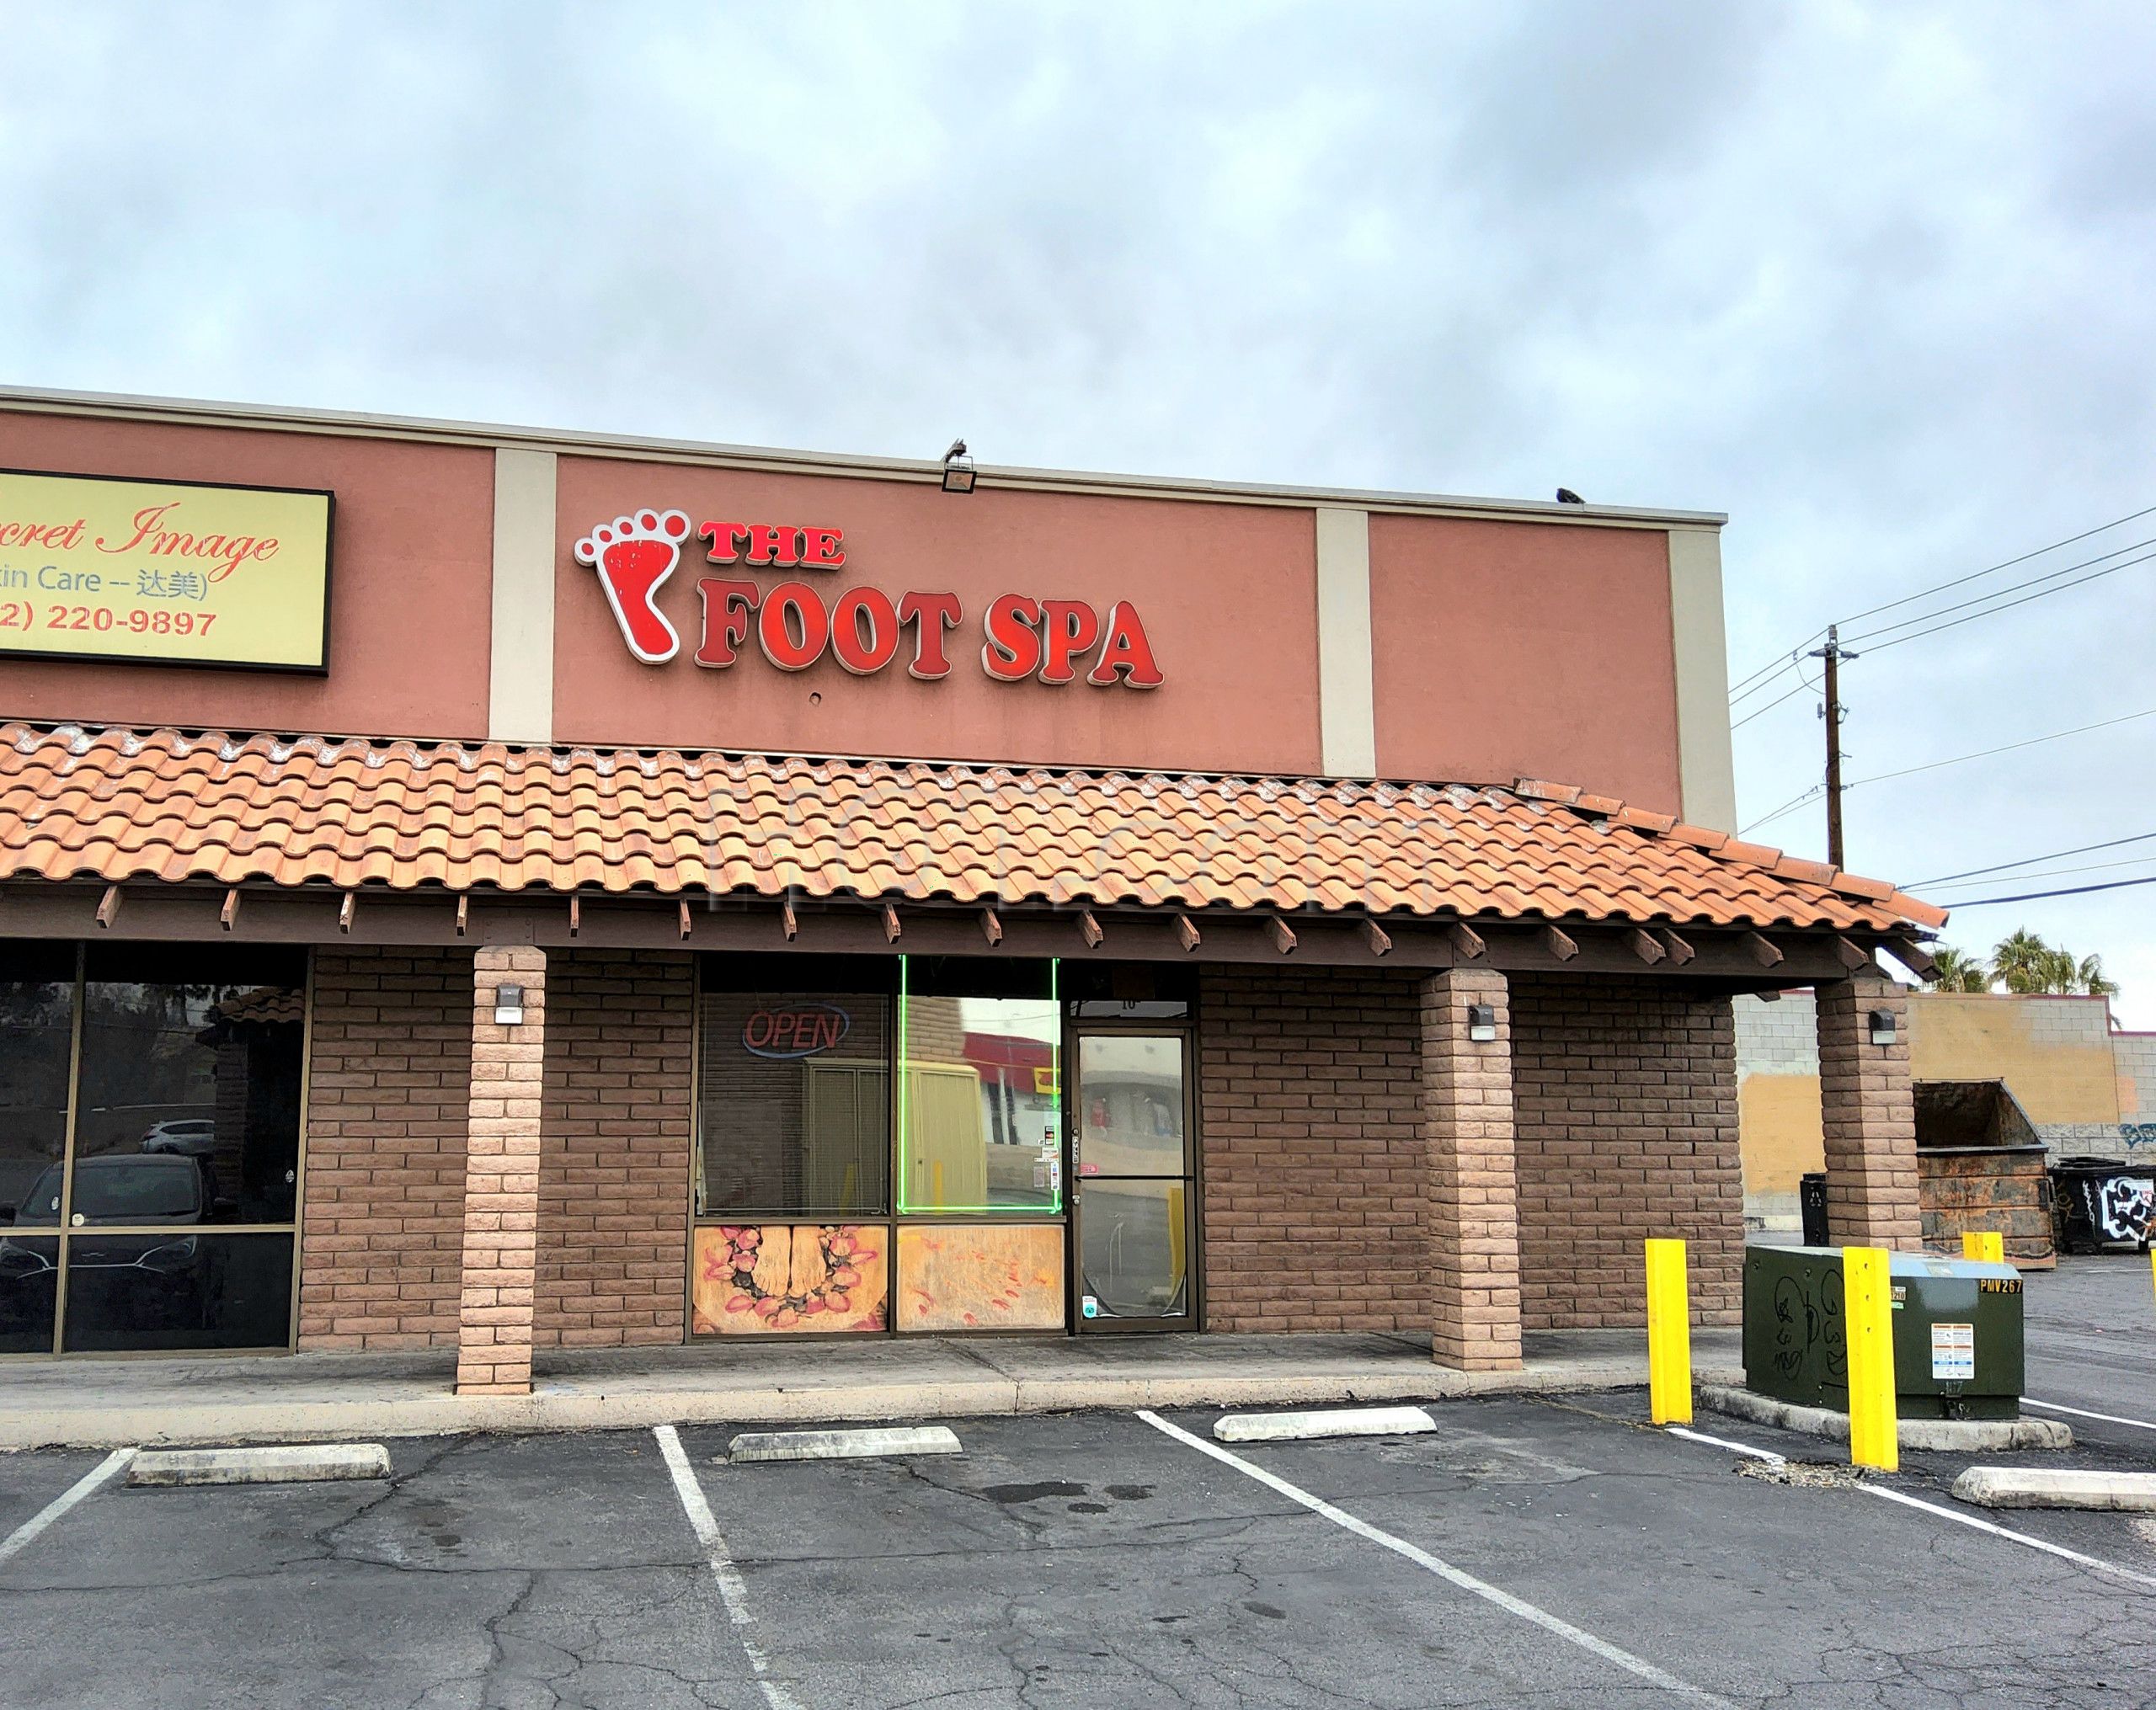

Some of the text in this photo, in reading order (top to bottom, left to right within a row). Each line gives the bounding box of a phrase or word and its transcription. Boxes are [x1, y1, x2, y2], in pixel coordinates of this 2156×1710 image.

[95, 502, 279, 583] Image
[698, 520, 846, 570] THE
[38, 566, 101, 592] Care
[46, 605, 217, 637] 220-9897
[694, 578, 1166, 690] FOOT SPA
[746, 1011, 841, 1048] OPEN
[1980, 1279, 2022, 1293] PMV267
